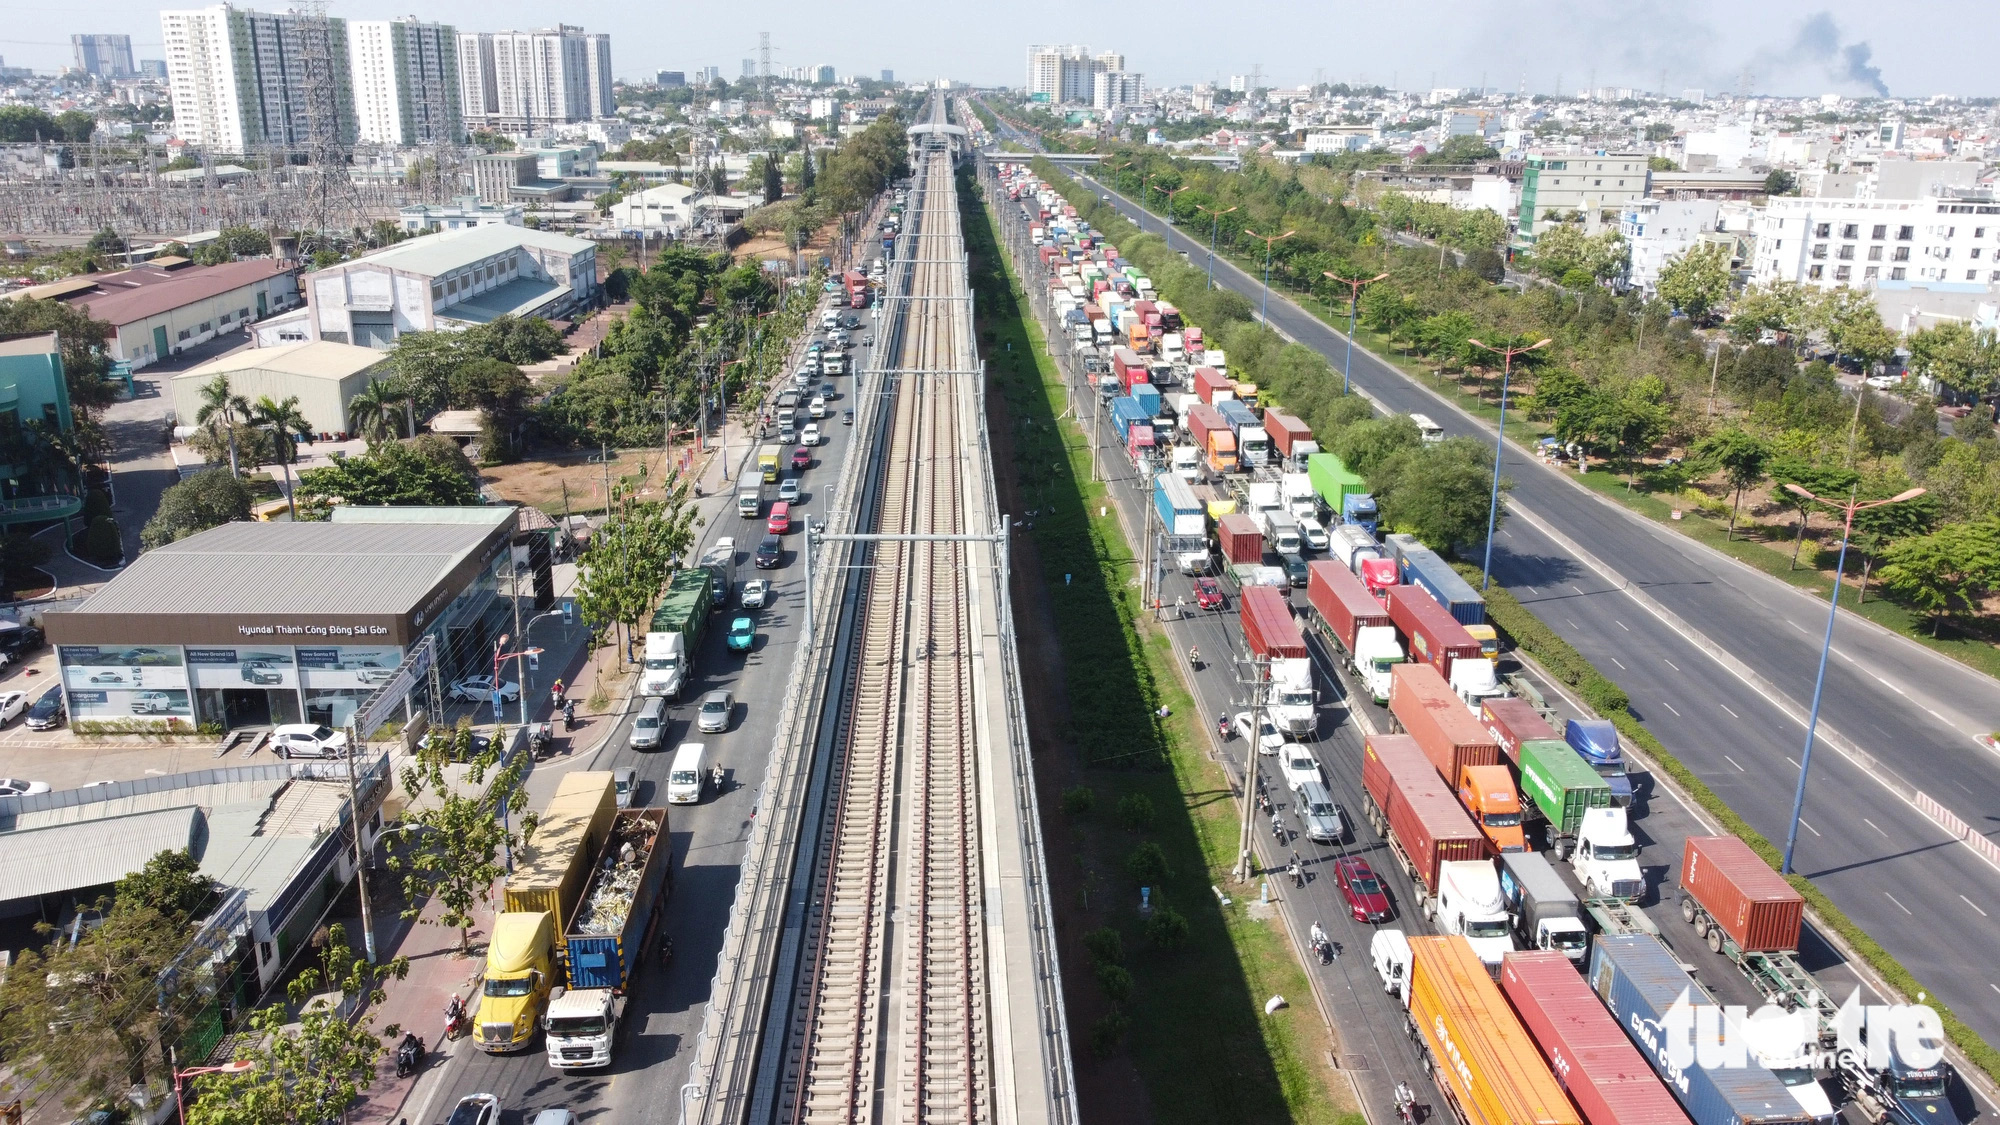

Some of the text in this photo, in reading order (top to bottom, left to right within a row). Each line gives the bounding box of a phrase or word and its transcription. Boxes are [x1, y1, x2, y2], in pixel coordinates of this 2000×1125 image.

[238, 625, 388, 636] Hyundai Thành Công Đông Sài Gòn
[1631, 1012, 1657, 1055] CMA
